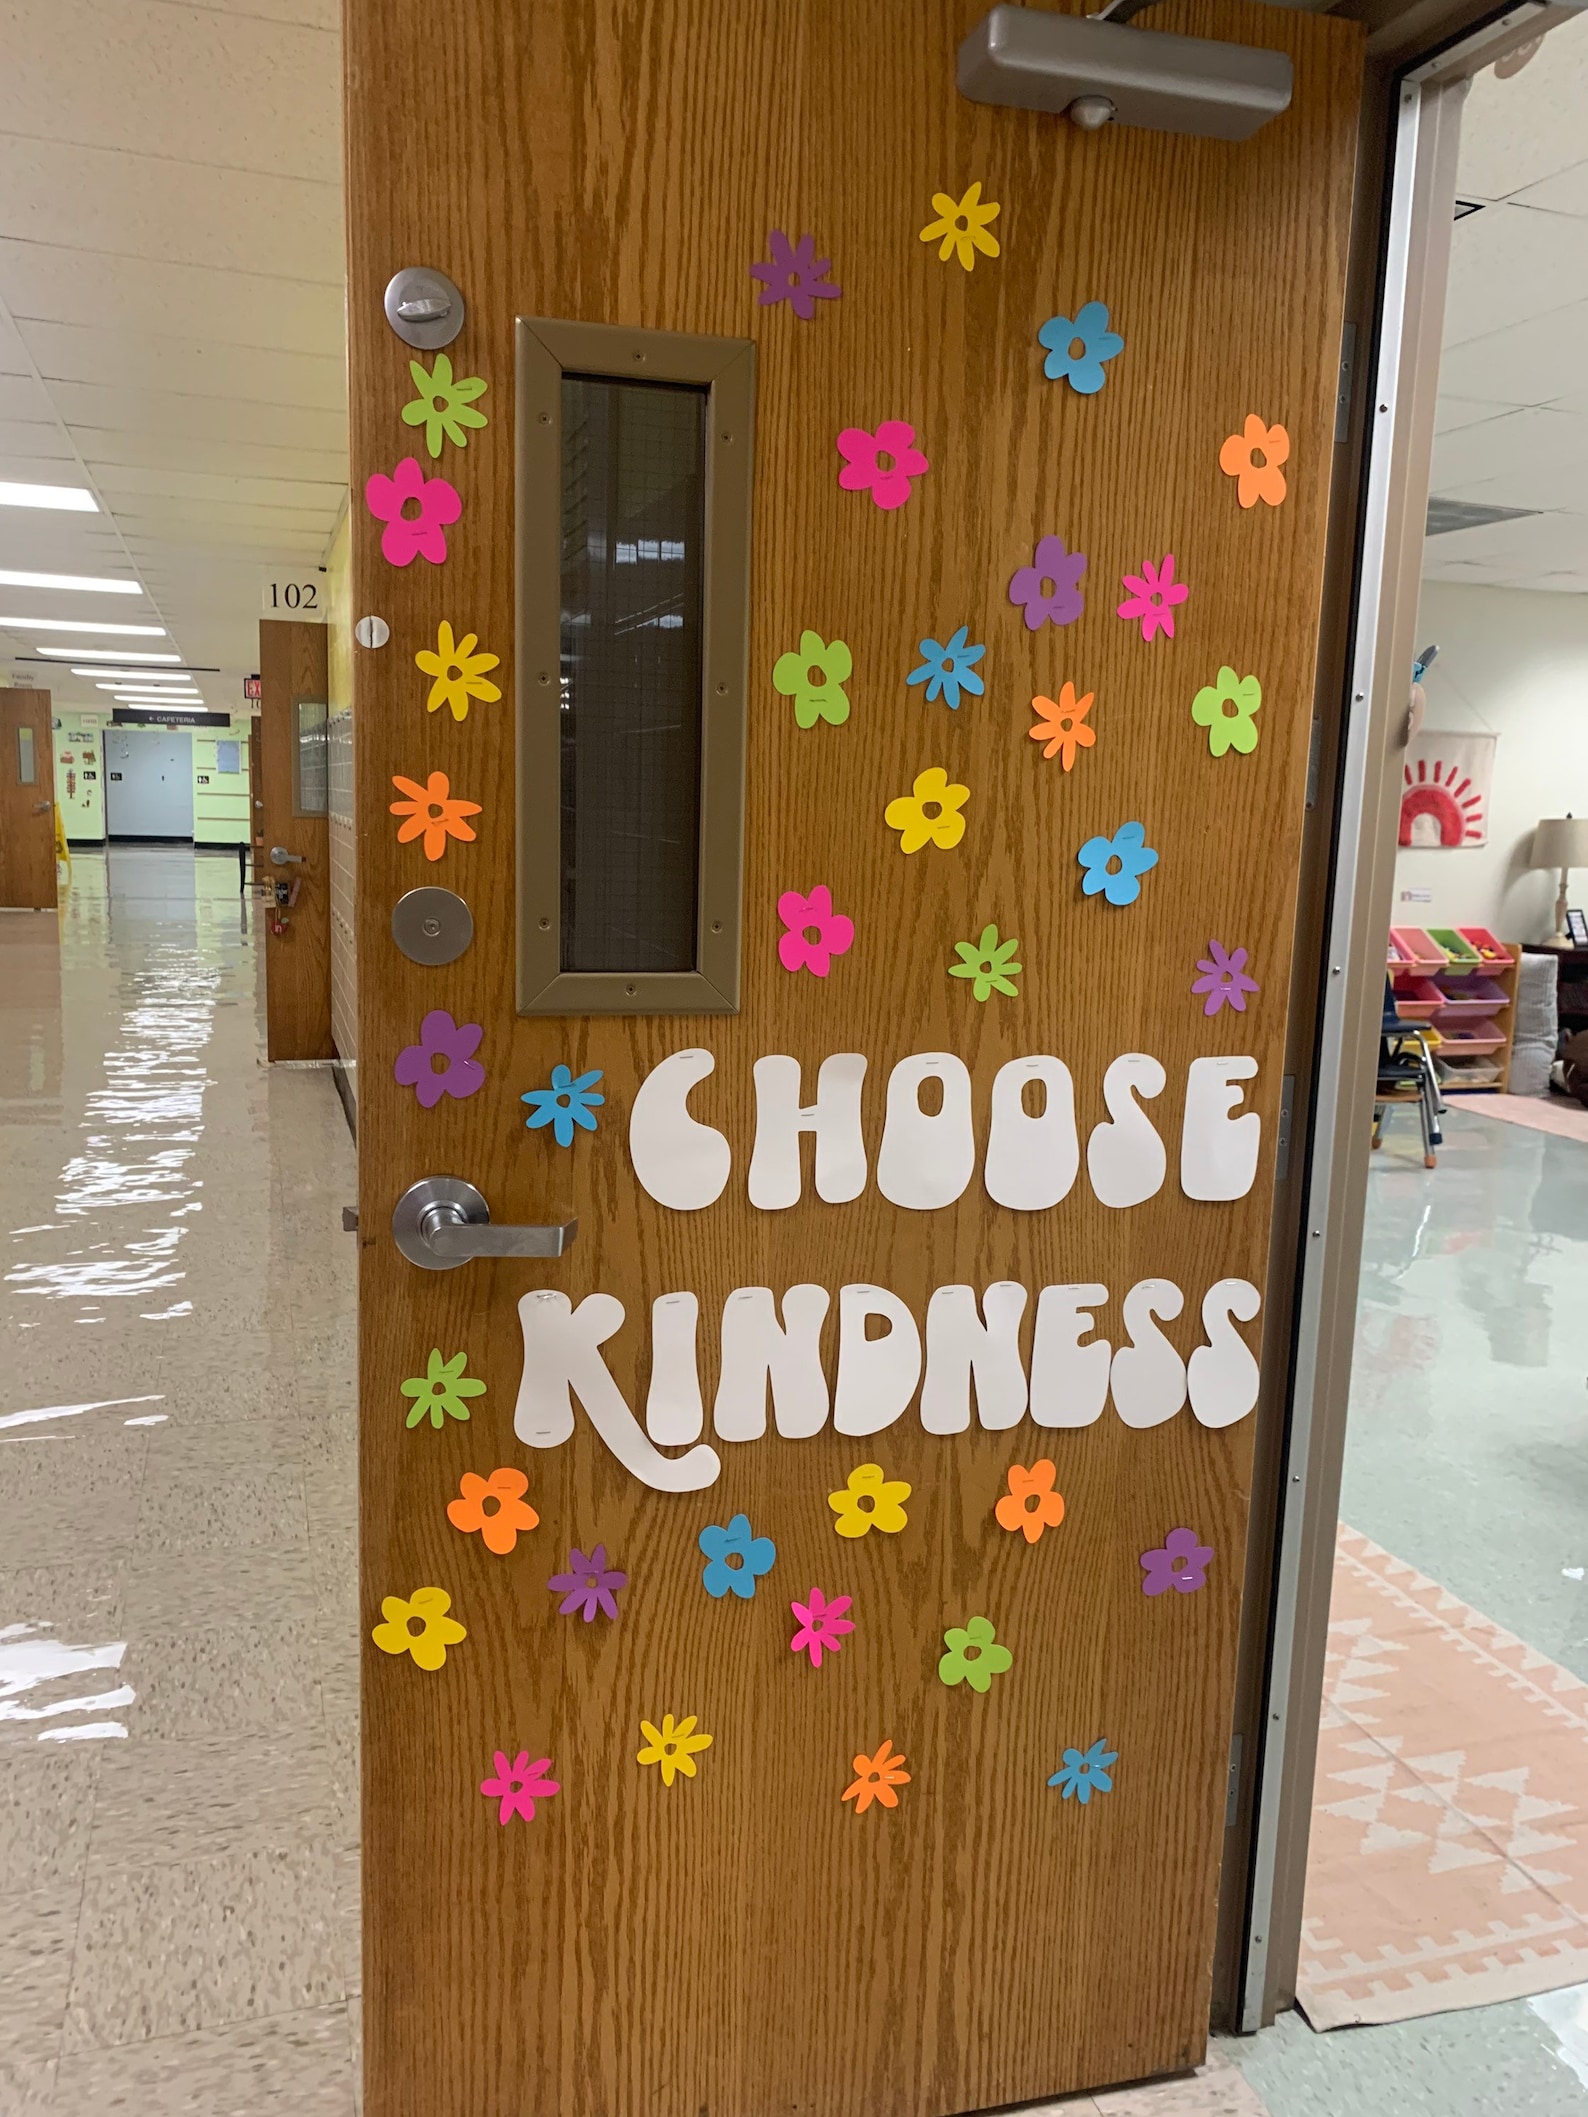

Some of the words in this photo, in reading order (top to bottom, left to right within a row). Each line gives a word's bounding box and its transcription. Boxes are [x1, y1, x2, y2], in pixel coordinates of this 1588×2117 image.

[269, 583, 318, 609] 102
[156, 716, 196, 725] CAFETERIA
[629, 1048, 1261, 1211] CHOOSE
[513, 1278, 1261, 1493] KINDNESS
